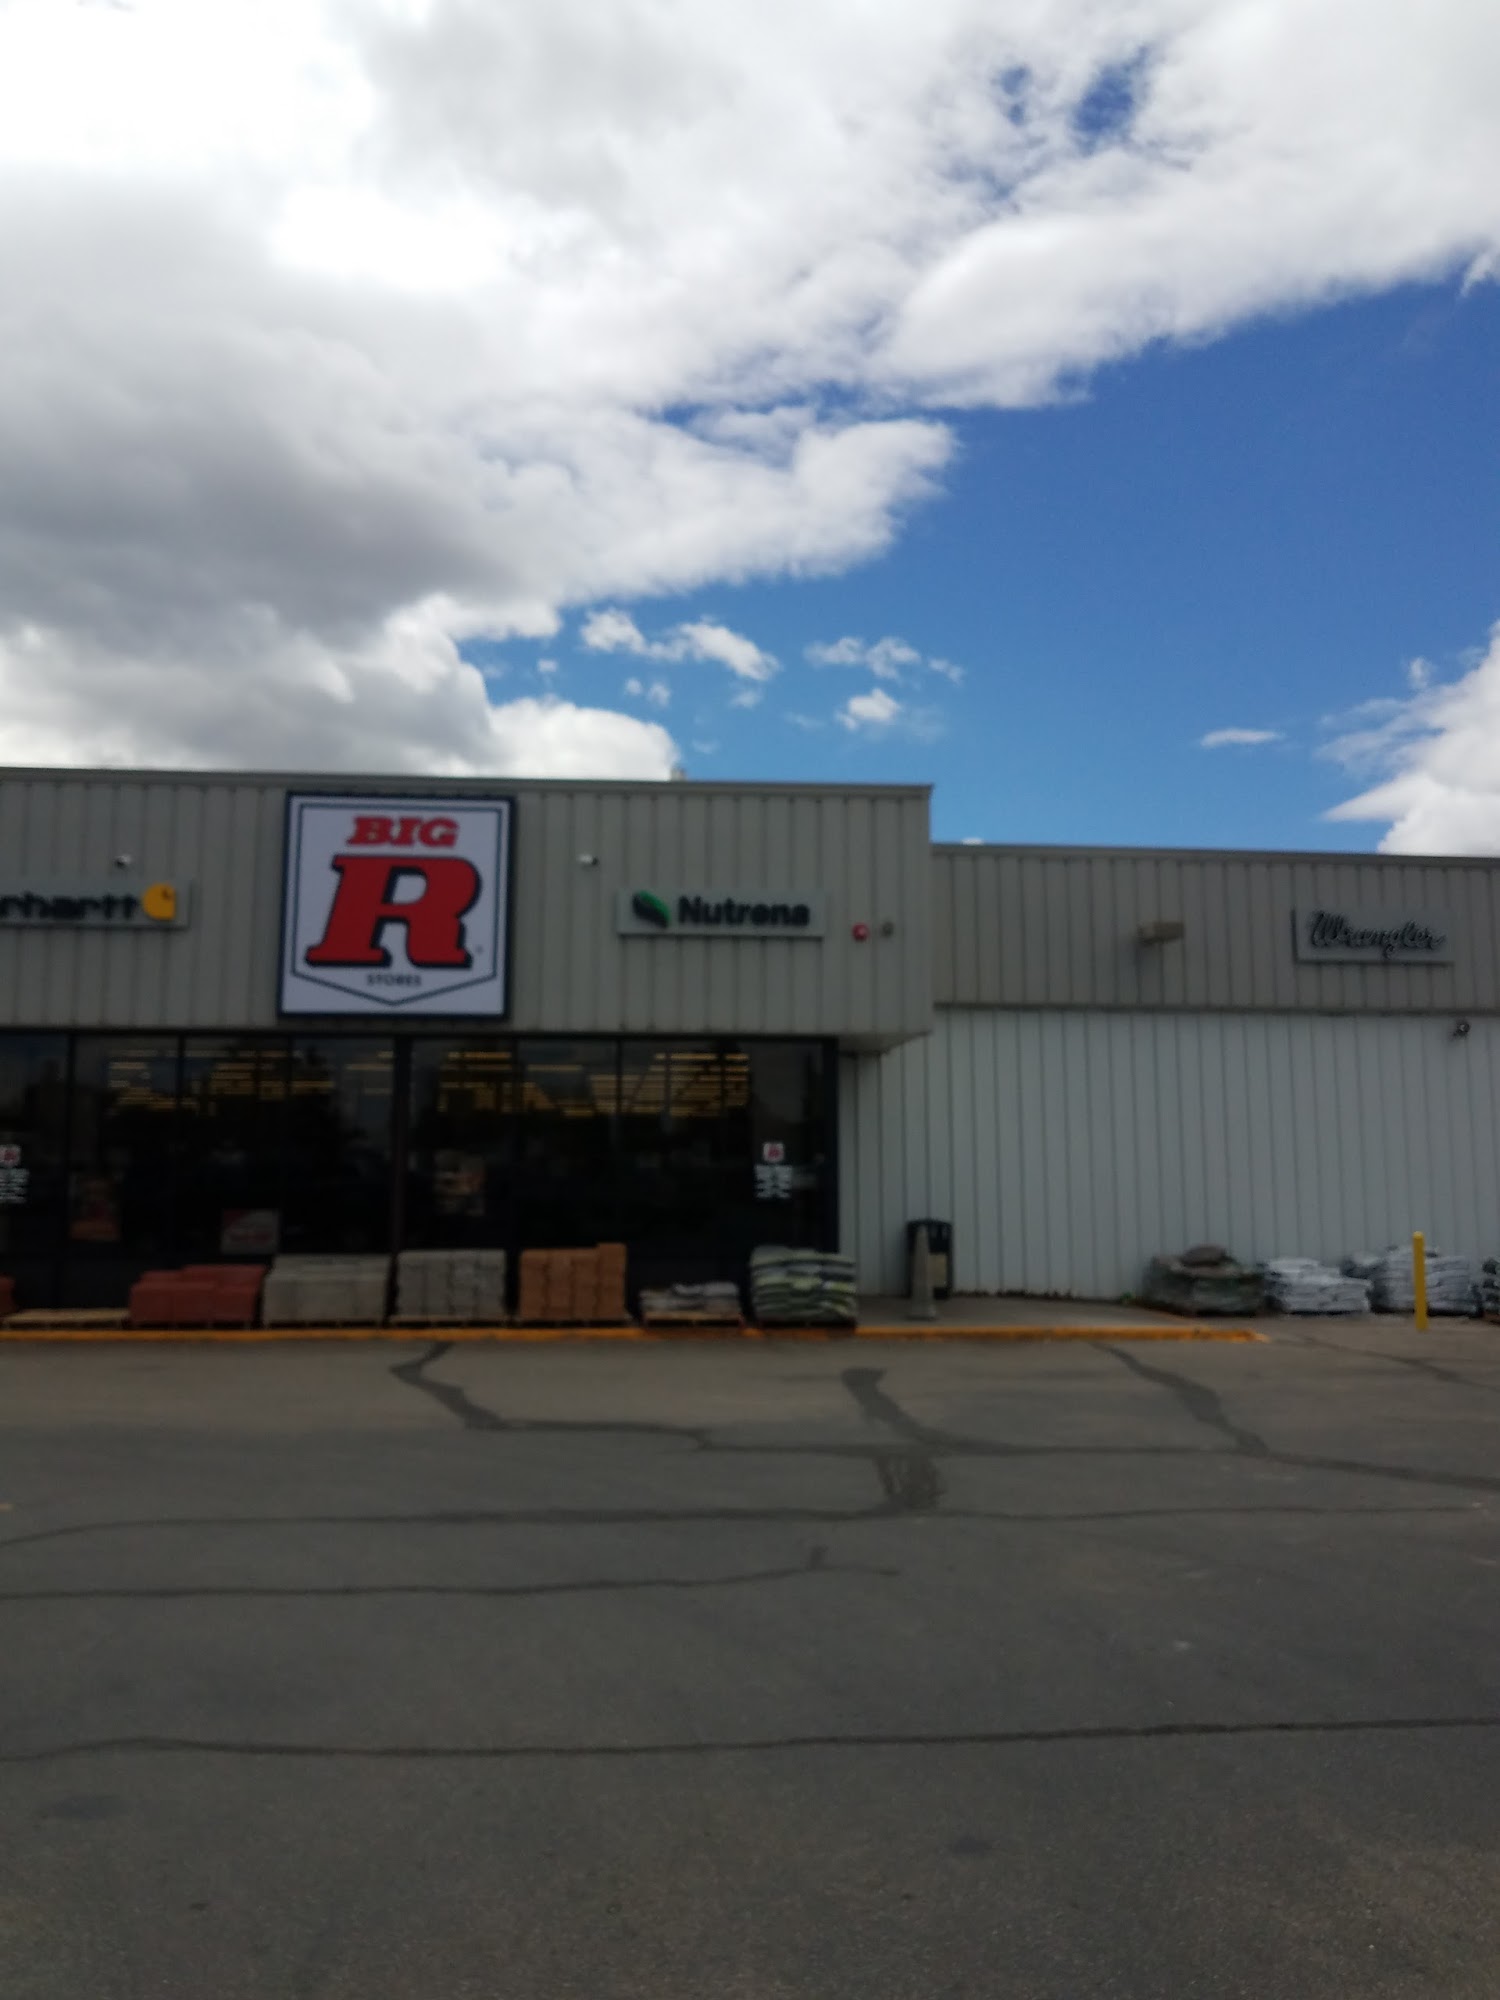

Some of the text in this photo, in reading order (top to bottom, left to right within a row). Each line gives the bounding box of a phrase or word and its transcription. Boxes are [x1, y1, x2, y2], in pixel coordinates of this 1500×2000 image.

[347, 817, 459, 847] BIG
[305, 854, 482, 968] R
[679, 895, 810, 926] Nutrena
[1310, 910, 1447, 960] Wrangler
[367, 974, 421, 986] STORES
